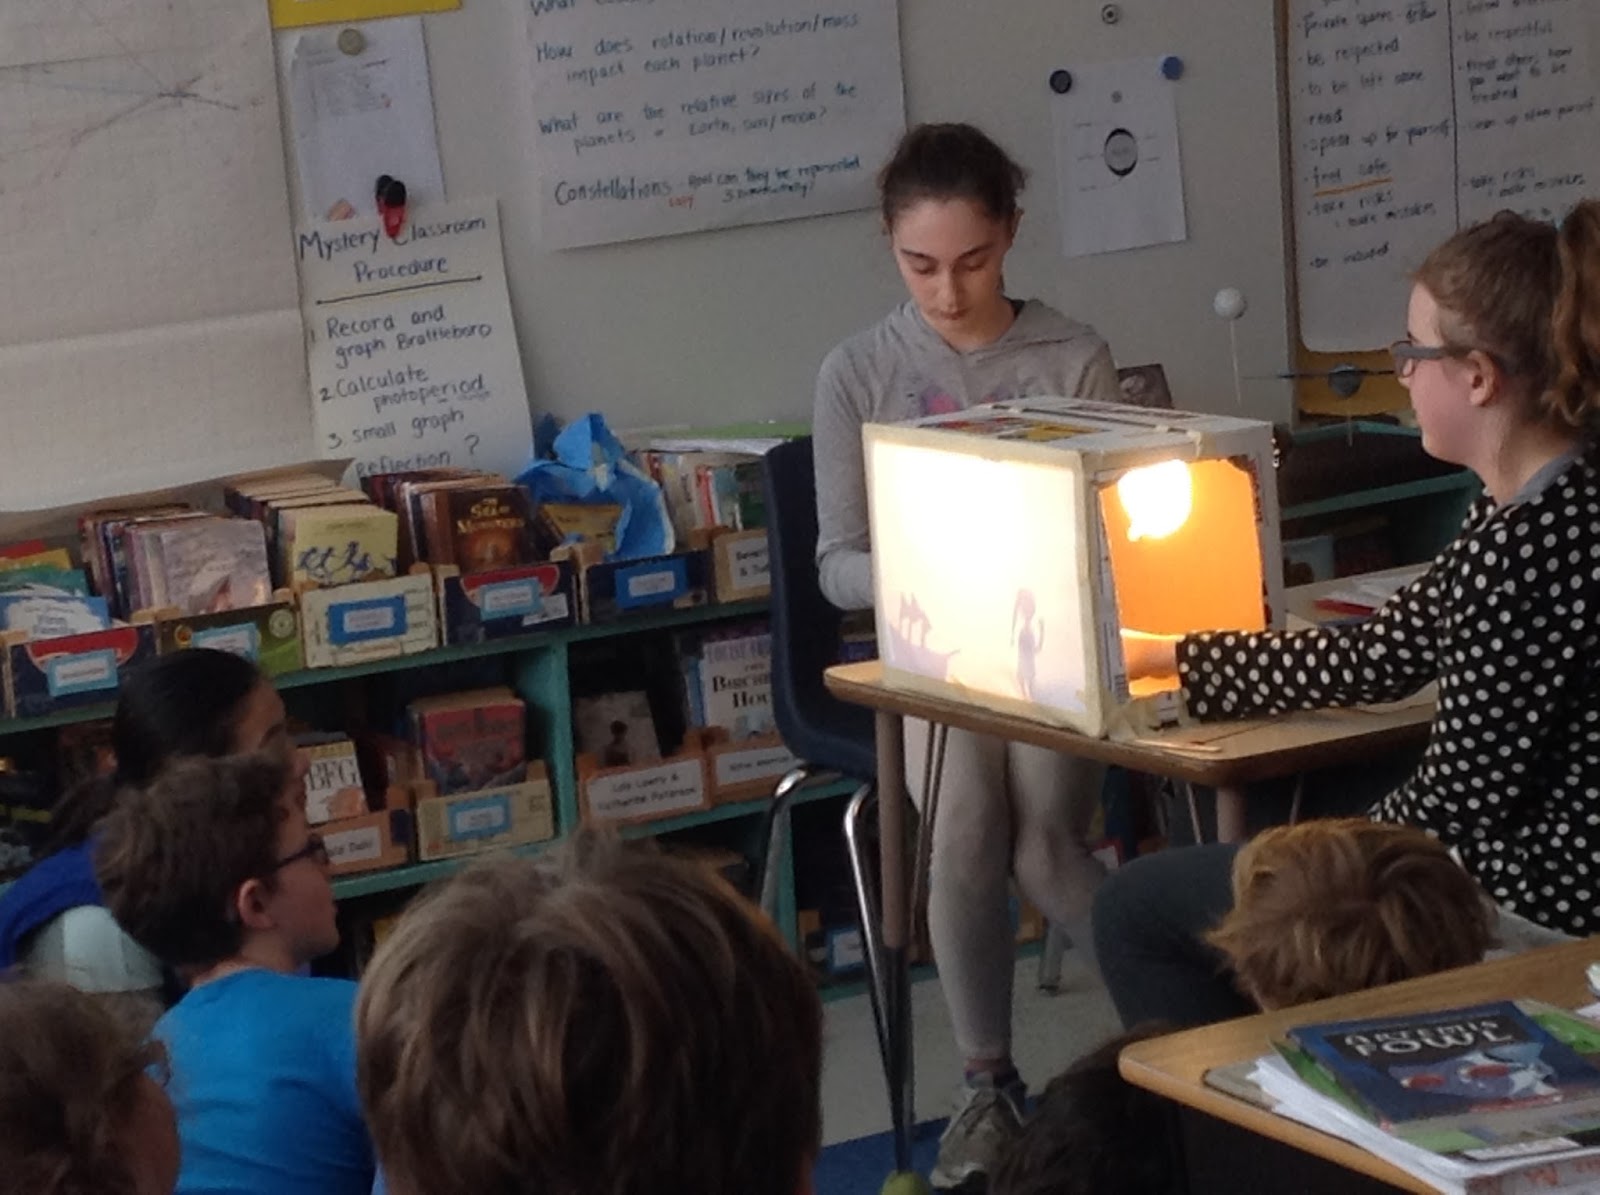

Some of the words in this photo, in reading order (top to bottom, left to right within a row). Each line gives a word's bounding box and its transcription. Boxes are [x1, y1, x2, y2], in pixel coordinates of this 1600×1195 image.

[536, 42, 573, 63] How
[594, 37, 633, 57] does
[566, 62, 624, 87] impact
[644, 57, 681, 75] each
[539, 114, 579, 135] What
[596, 108, 624, 124] are
[643, 101, 665, 122] the
[573, 127, 636, 155] planets
[554, 176, 673, 206] Constellations
[299, 226, 380, 261] Mystery
[353, 255, 449, 283] Procedure
[326, 313, 395, 341] Record
[411, 304, 445, 326] and
[335, 337, 386, 370] graph
[396, 322, 493, 351] Brattleboro
[336, 363, 429, 398] Calculate
[372, 373, 484, 413] photoperiod
[411, 405, 464, 439] graph
